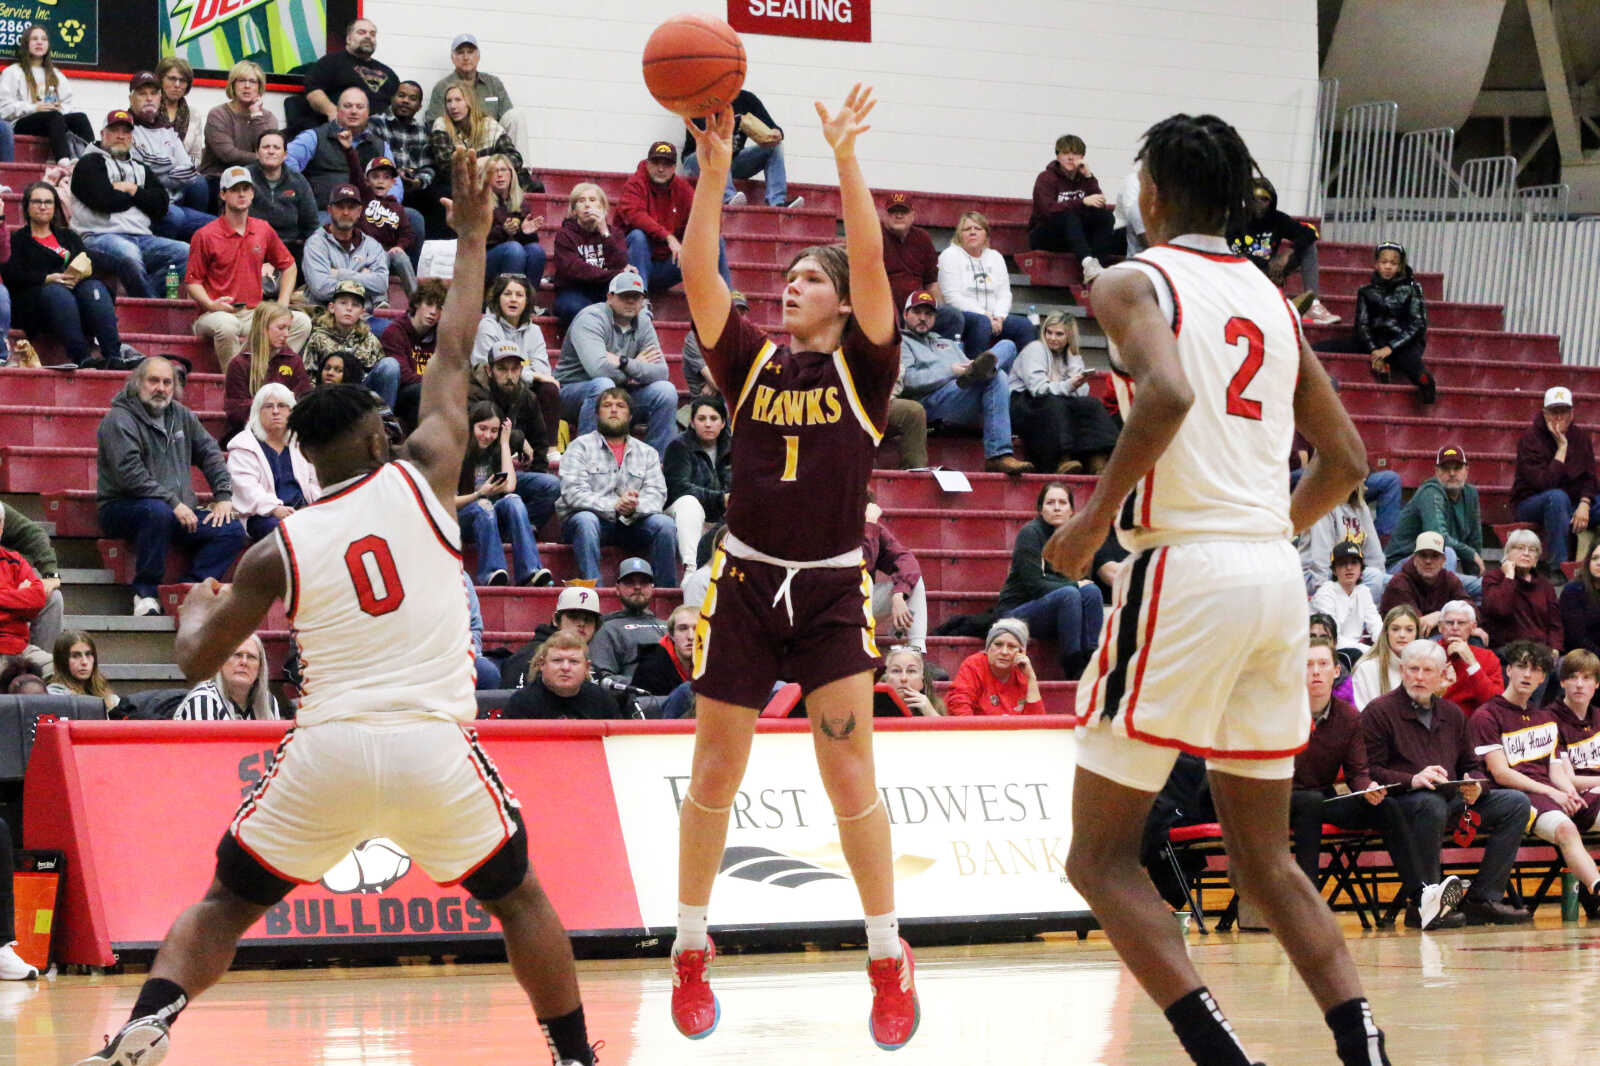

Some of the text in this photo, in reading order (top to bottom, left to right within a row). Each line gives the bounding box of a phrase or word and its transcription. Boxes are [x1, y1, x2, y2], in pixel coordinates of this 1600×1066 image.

[748, 0, 853, 23] SEATING
[1224, 316, 1265, 421] 2
[751, 384, 842, 426] HAWKS
[780, 435, 799, 481] 1
[344, 533, 405, 617] 0
[579, 591, 589, 604] P
[663, 775, 1051, 829] FRST IDWEST
[951, 837, 1067, 877] BANK
[265, 896, 493, 936] BULLDOGS
